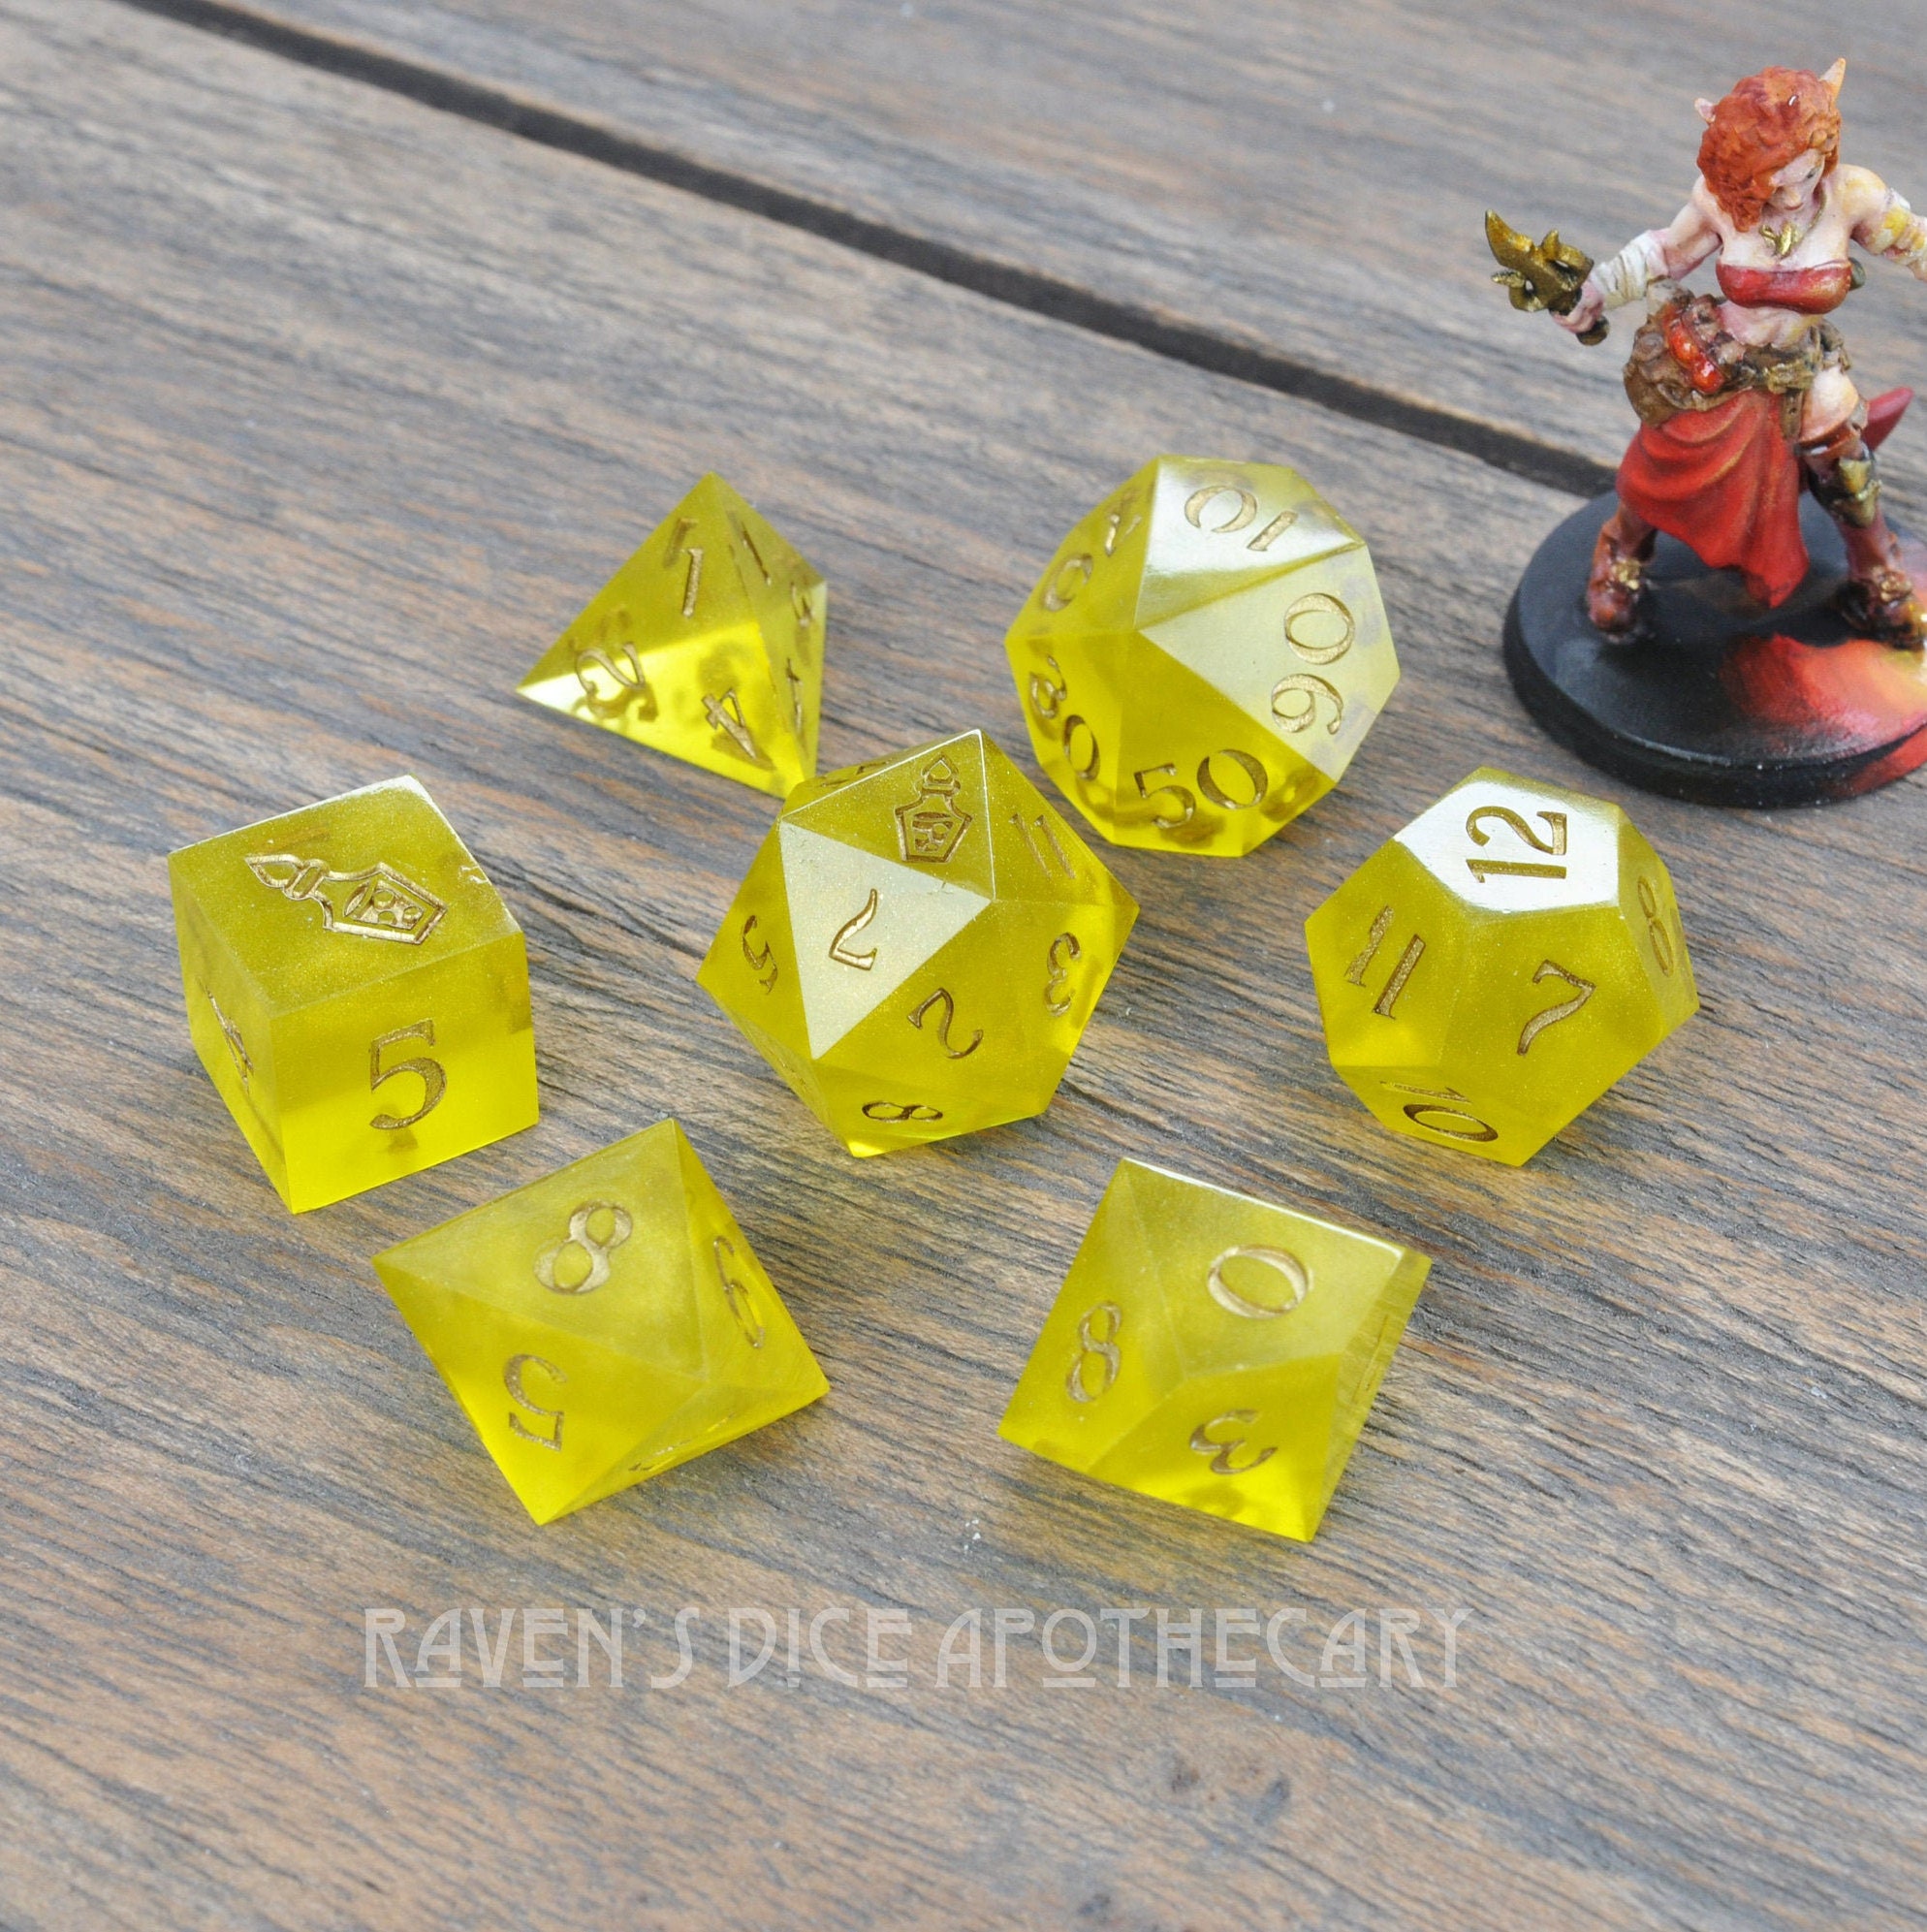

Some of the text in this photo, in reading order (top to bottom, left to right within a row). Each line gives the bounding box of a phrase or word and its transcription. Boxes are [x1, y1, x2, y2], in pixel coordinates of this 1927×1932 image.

[682, 548, 704, 618] 1
[701, 687, 757, 760] 4
[1133, 748, 1269, 830] 50
[1465, 805, 1568, 884] 12
[829, 888, 878, 971] 7
[1637, 875, 1674, 978] 8
[1045, 931, 1082, 1018] 3
[1516, 958, 1597, 1057] 7
[907, 987, 984, 1060] 2
[368, 1018, 449, 1130] 5
[861, 1099, 944, 1124] 8
[1379, 1080, 1500, 1143] 10
[532, 1198, 634, 1295] 8
[1207, 1244, 1311, 1320] 0
[1065, 1299, 1123, 1405] 8
[502, 1352, 568, 1452] 5
[1188, 1408, 1279, 1476] 3
